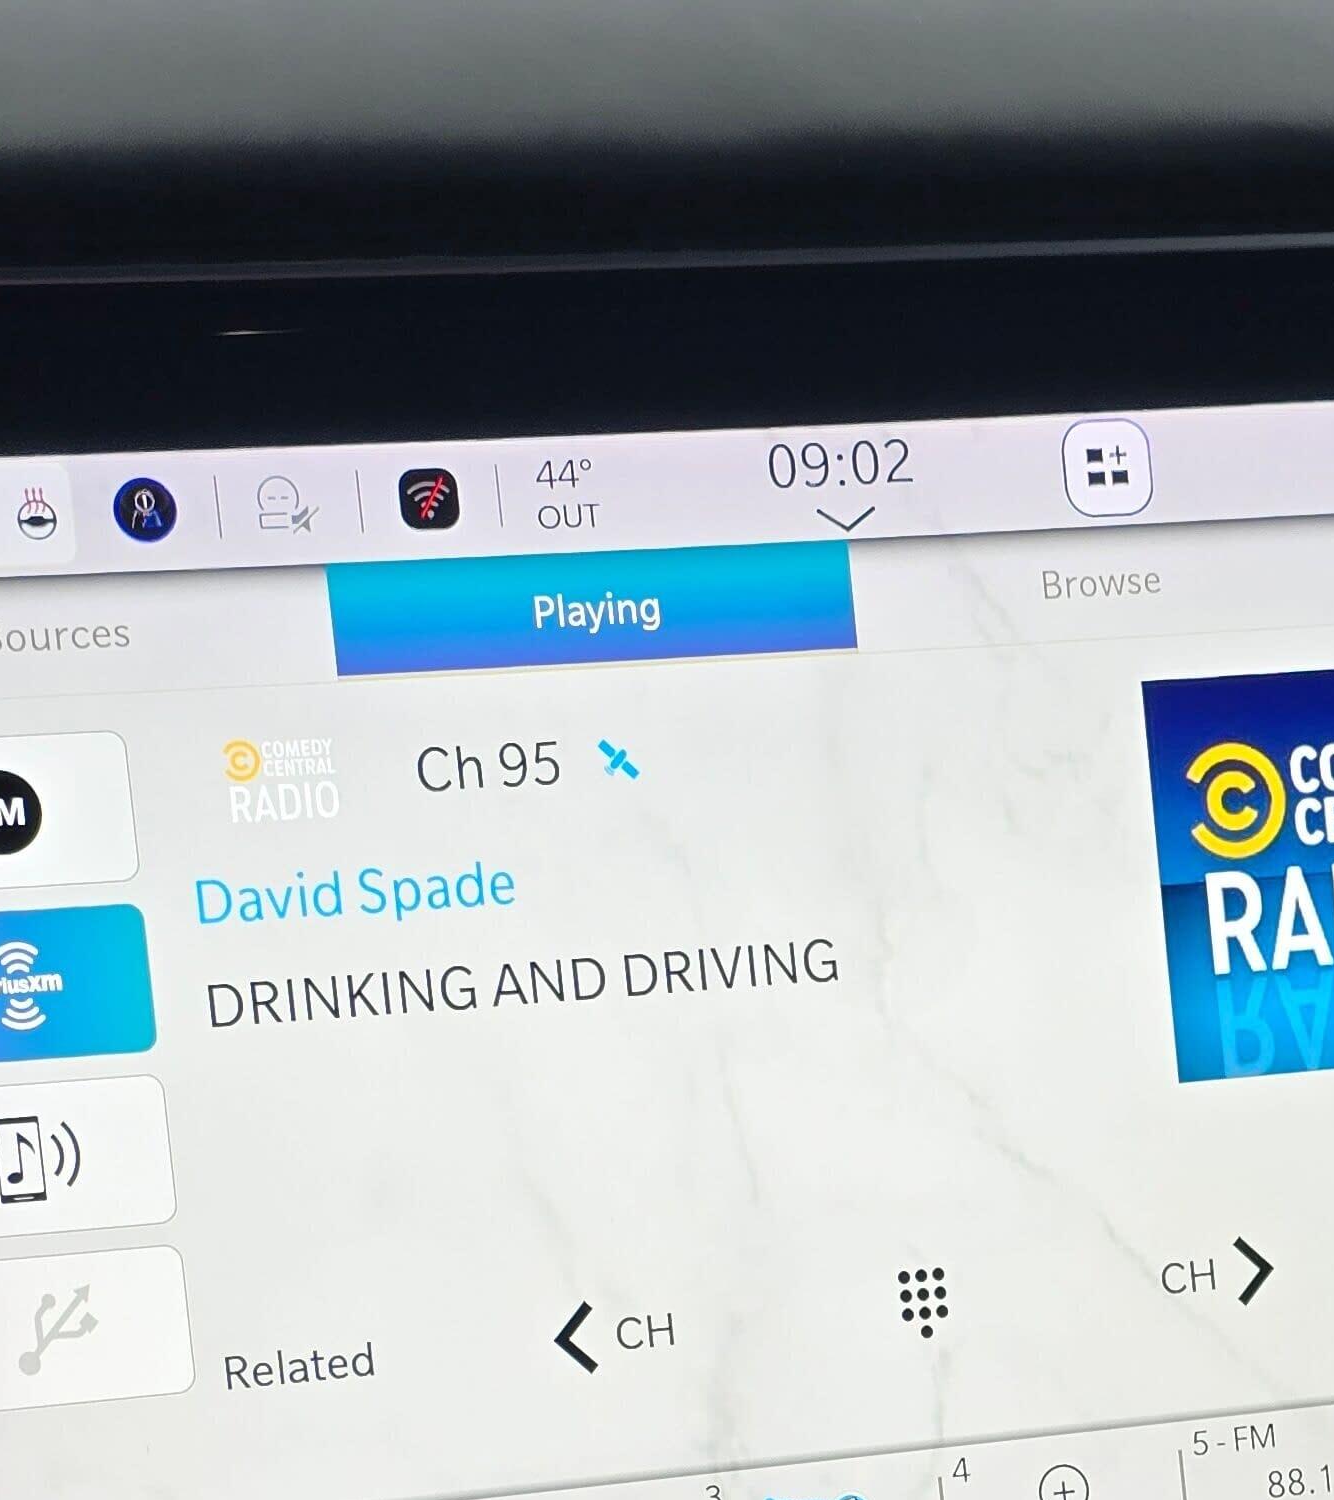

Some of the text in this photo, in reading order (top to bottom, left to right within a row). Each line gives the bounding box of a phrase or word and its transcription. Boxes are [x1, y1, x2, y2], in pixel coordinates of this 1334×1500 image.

[536, 458, 592, 490] 44°
[768, 438, 914, 489] 09:02
[537, 503, 600, 530] OUT
[1042, 568, 1162, 600] Browse
[533, 592, 661, 634] Playing
[261, 738, 334, 759] COMEDY
[263, 757, 337, 777] CENTRAL
[417, 740, 561, 793] Ch 95
[229, 780, 340, 823] RADIO
[196, 861, 516, 925] David Spade
[208, 938, 840, 1028] DRINKING AND DRIVING
[1161, 1258, 1216, 1295] CH
[615, 1313, 675, 1350] CH
[224, 1342, 377, 1390] Related
[952, 1458, 970, 1483] 4
[1268, 1465, 1331, 1498] 88.1
